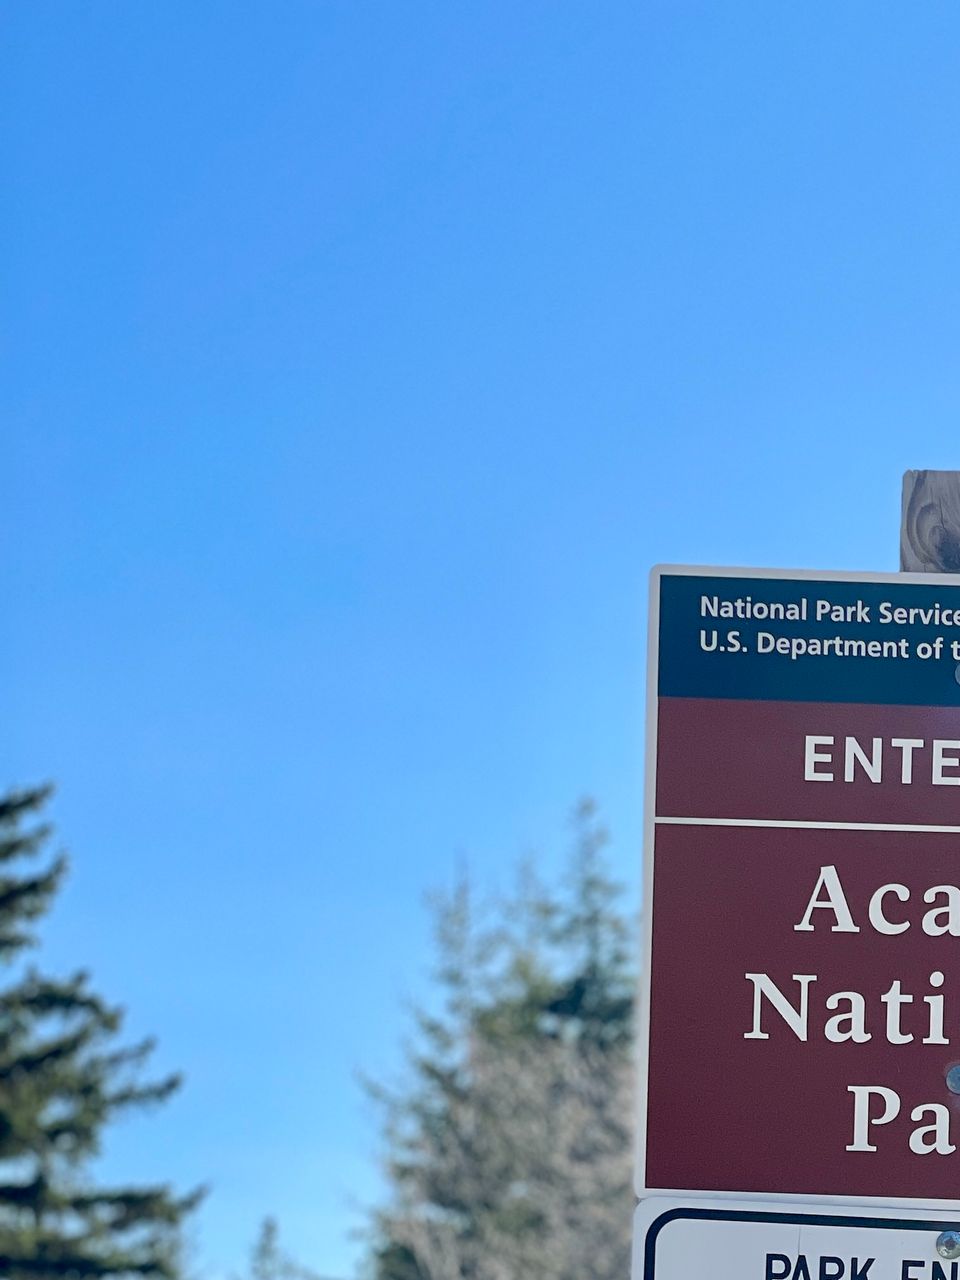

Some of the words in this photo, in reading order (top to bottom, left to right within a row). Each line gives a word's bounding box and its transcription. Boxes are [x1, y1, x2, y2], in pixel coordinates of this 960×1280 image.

[700, 595, 808, 621] National
[816, 599, 871, 623] Park
[700, 630, 748, 653] U.S.
[757, 632, 909, 660] Department
[916, 636, 944, 660] of
